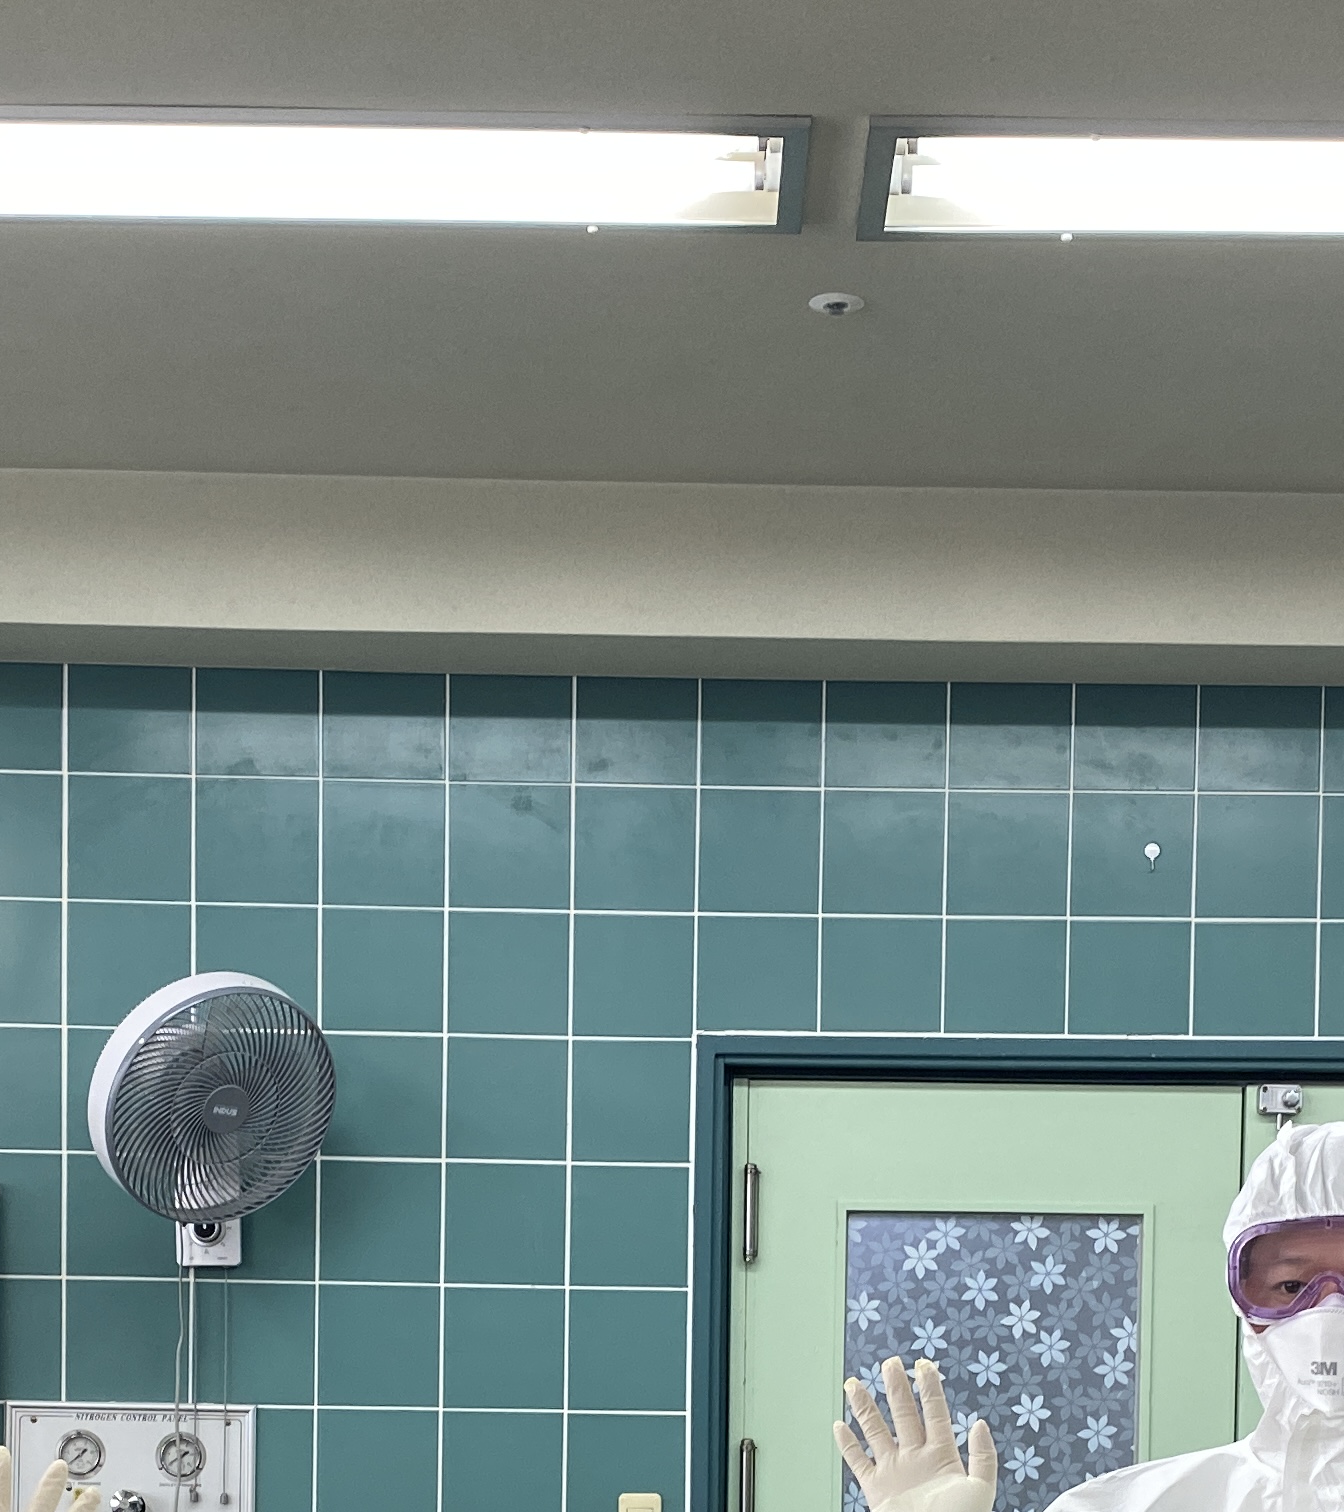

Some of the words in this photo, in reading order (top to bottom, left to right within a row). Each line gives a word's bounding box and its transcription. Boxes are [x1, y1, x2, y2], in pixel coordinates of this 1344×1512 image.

[1310, 1361, 1338, 1376] 3M
[75, 1412, 118, 1421] NITROGEN
[120, 1413, 158, 1422] CONTROL
[161, 1414, 189, 1423] PAEL
